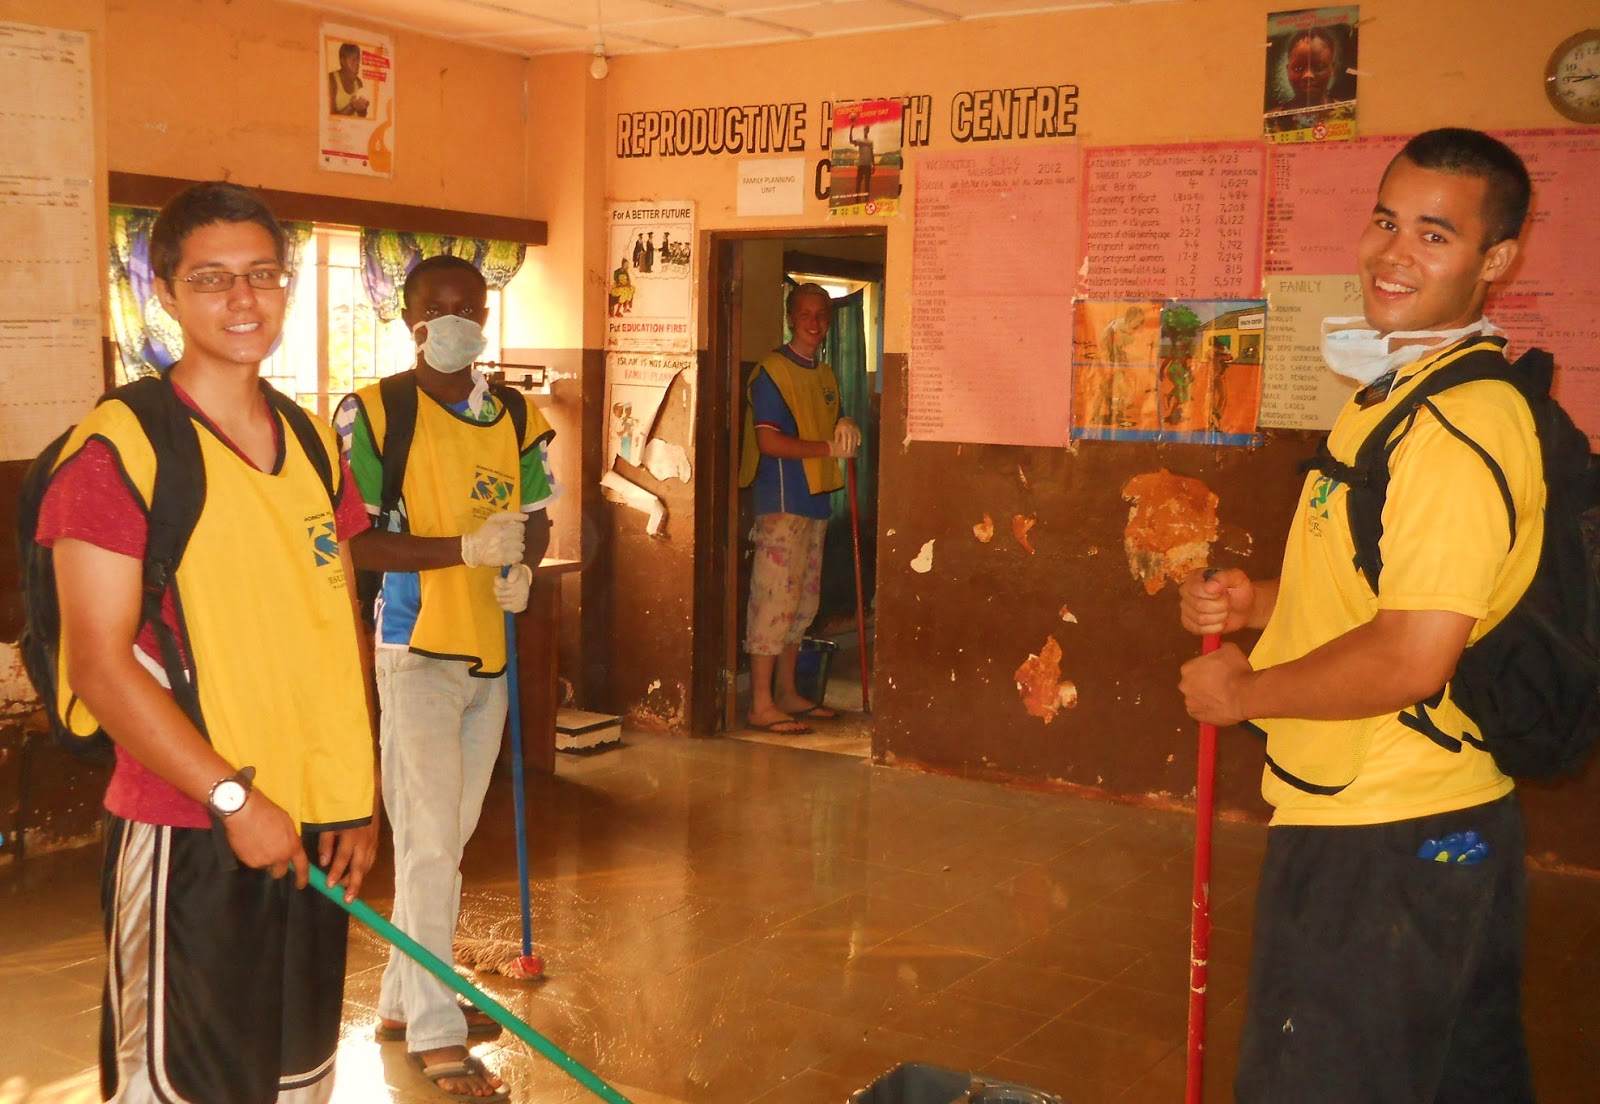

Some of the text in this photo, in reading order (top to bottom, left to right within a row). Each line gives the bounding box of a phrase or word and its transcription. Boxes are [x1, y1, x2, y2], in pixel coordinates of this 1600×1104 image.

[617, 103, 807, 158] REPRODUCTIVE
[950, 85, 1079, 142] CENTRE
[1038, 162, 1062, 174] 2012
[761, 186, 777, 194] UNIT
[612, 208, 691, 220] For A BETTER FUTURE
[1279, 280, 1322, 293] FAMILY
[609, 323, 688, 334] Put EDUCATION FIRST
[617, 356, 638, 366] ISLAM
[640, 359, 648, 367] IS
[649, 360, 662, 368] NOT
